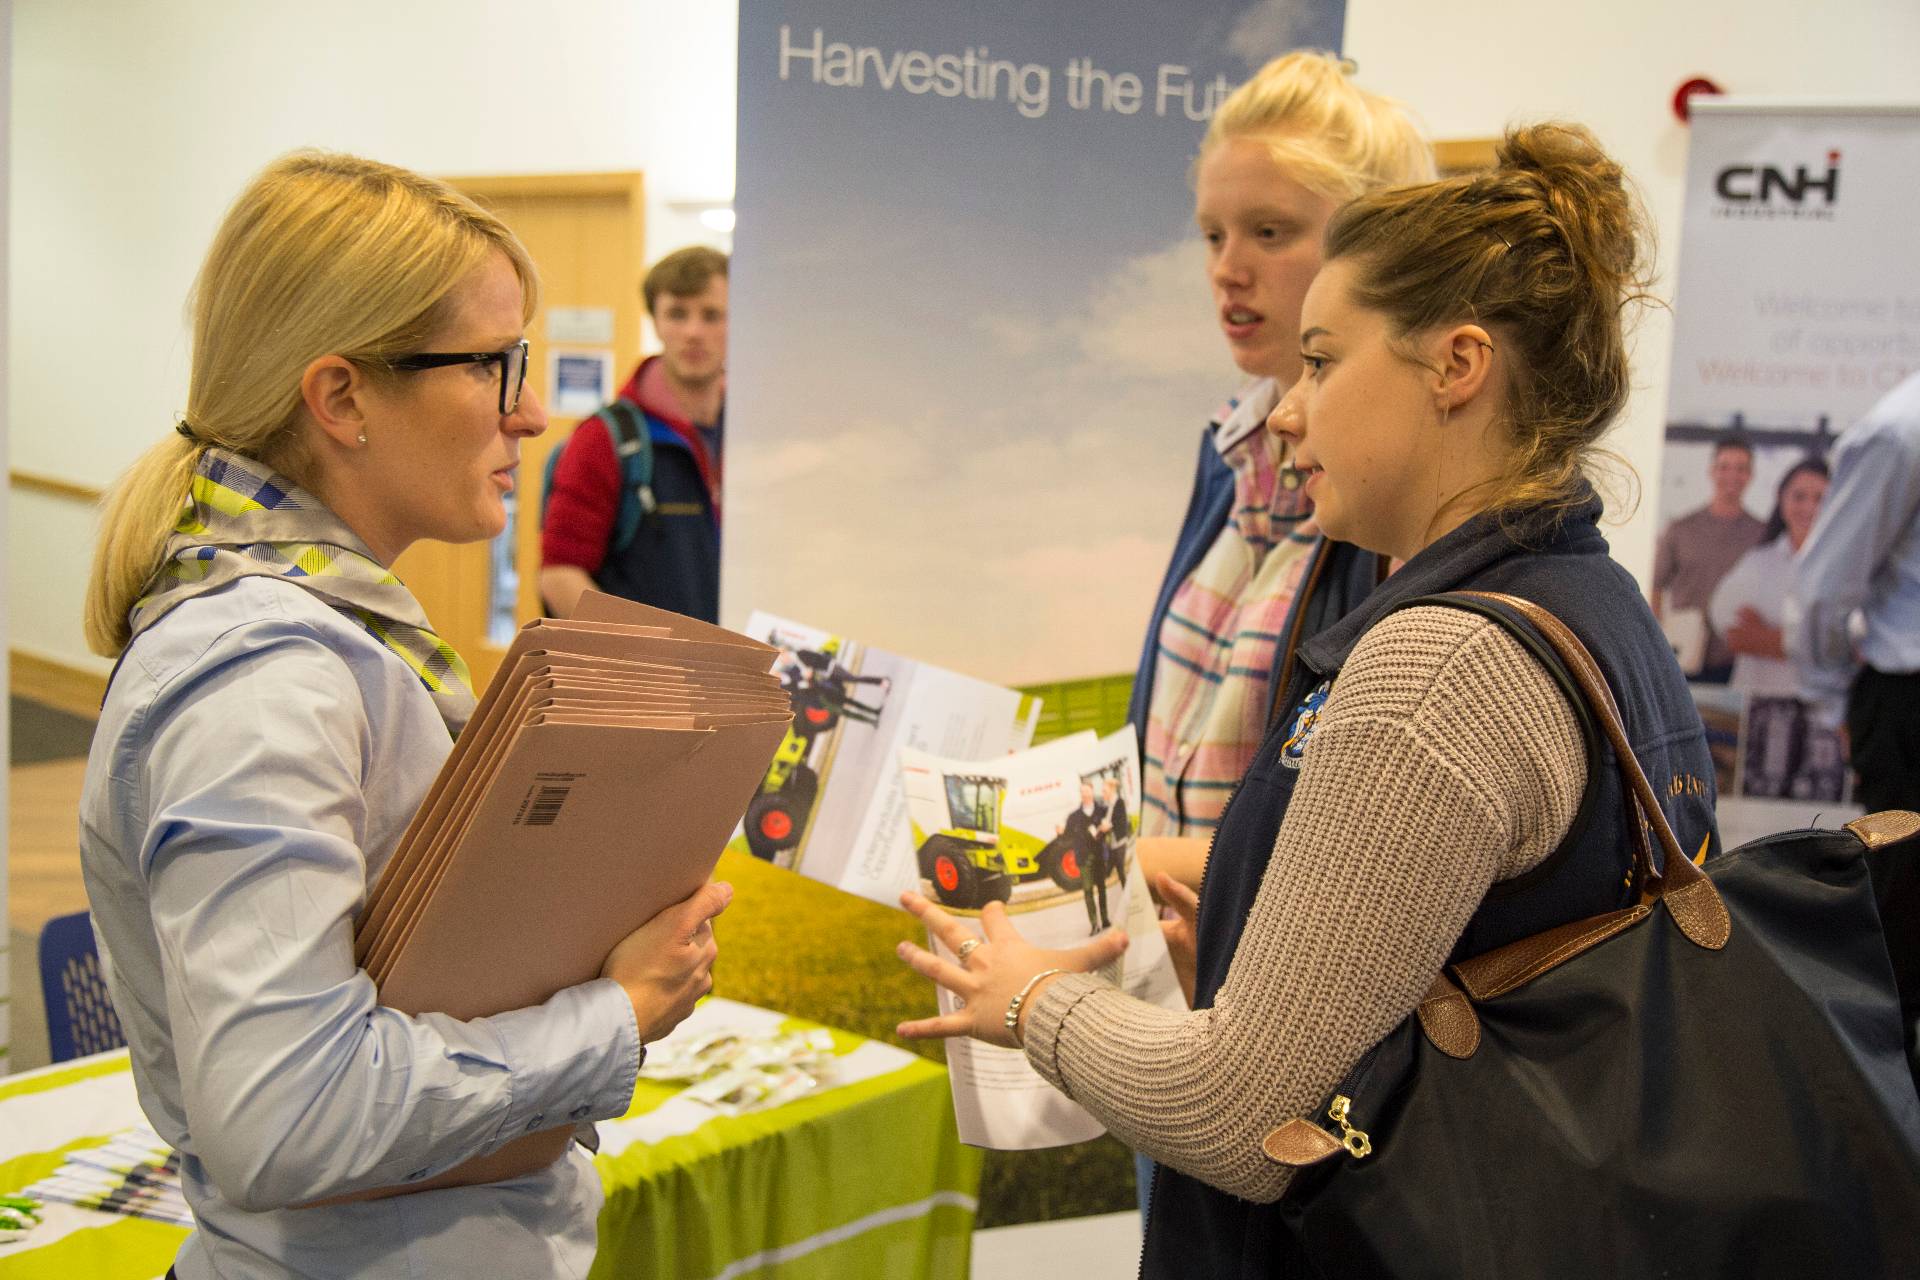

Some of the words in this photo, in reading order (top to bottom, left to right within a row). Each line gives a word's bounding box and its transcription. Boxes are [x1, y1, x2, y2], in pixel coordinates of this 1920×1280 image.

[779, 25, 1050, 118] Harvesting
[1066, 57, 1143, 114] the
[1156, 64, 1231, 121] Fut
